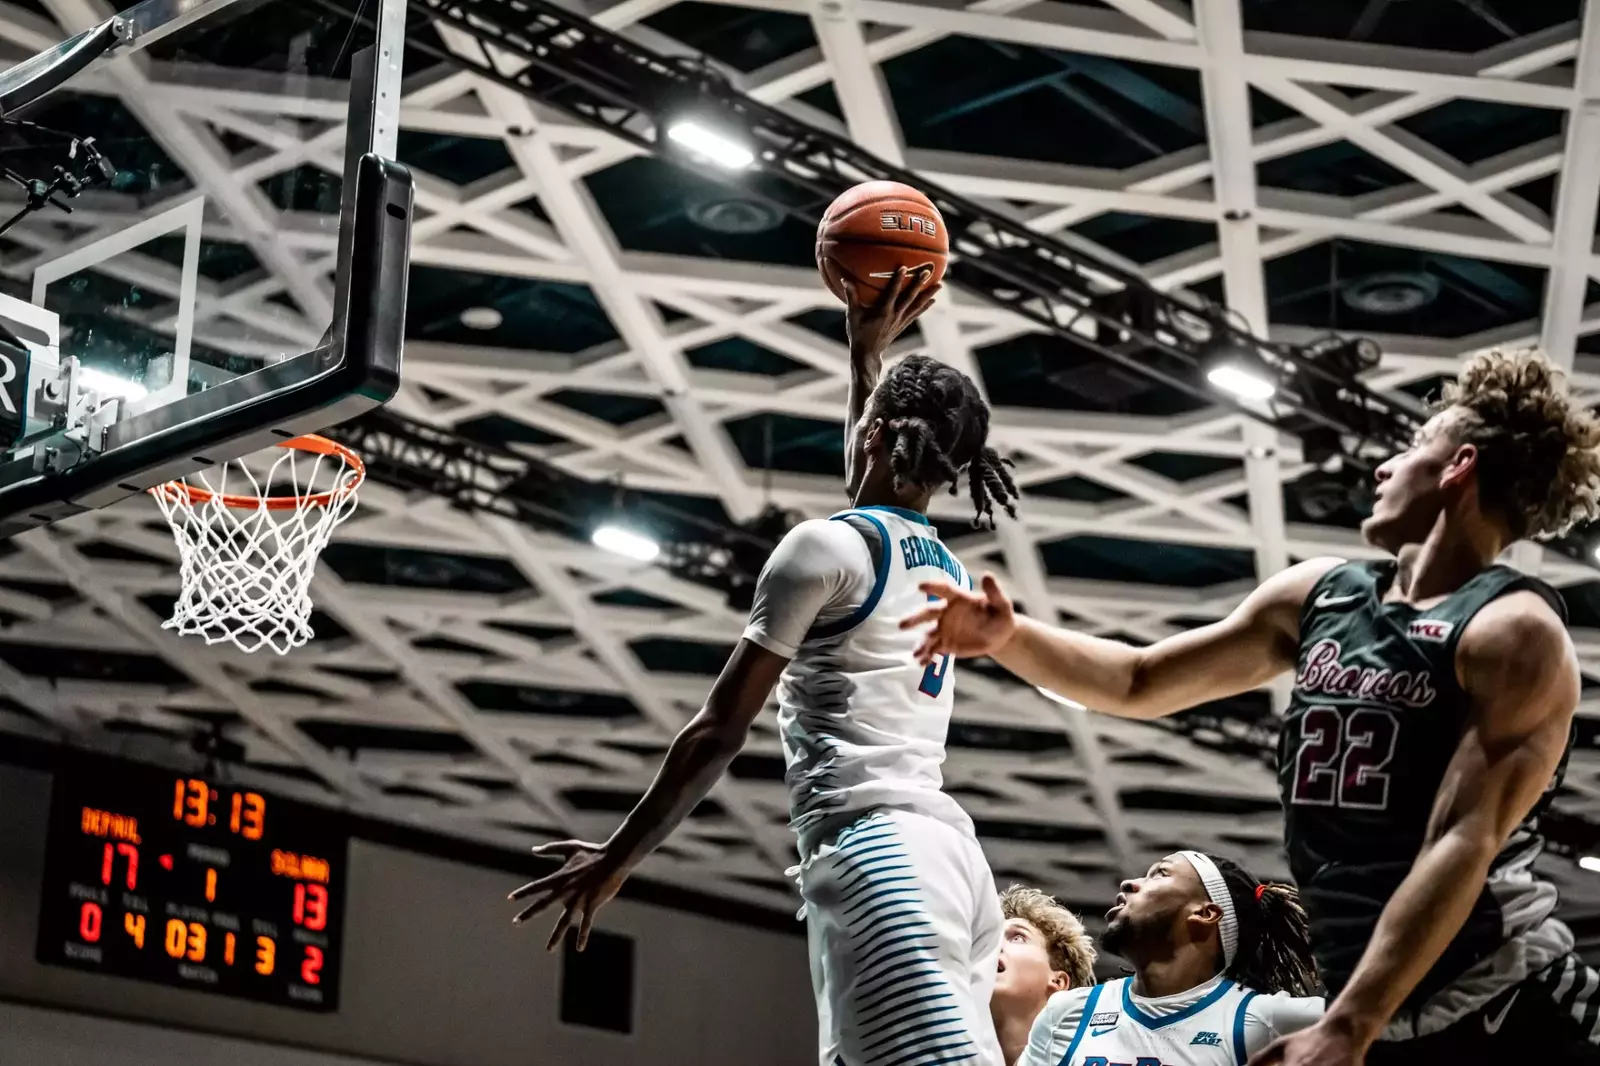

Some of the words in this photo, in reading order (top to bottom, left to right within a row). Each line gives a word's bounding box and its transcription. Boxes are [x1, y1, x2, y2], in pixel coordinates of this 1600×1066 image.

[880, 212, 936, 238] ELITE
[1409, 624, 1445, 638] WCC
[1296, 638, 1437, 708] Broncos
[1290, 705, 1400, 810] 22
[172, 778, 266, 840] 13:13
[101, 842, 139, 890] 17
[205, 868, 217, 902] 1
[79, 902, 103, 942] 0
[292, 883, 329, 931] 13
[124, 912, 147, 949] 4
[165, 918, 208, 962] 03
[223, 932, 236, 966] 1
[254, 936, 276, 976] 3
[301, 945, 324, 985] 2
[1189, 1036, 1223, 1046] EAST
